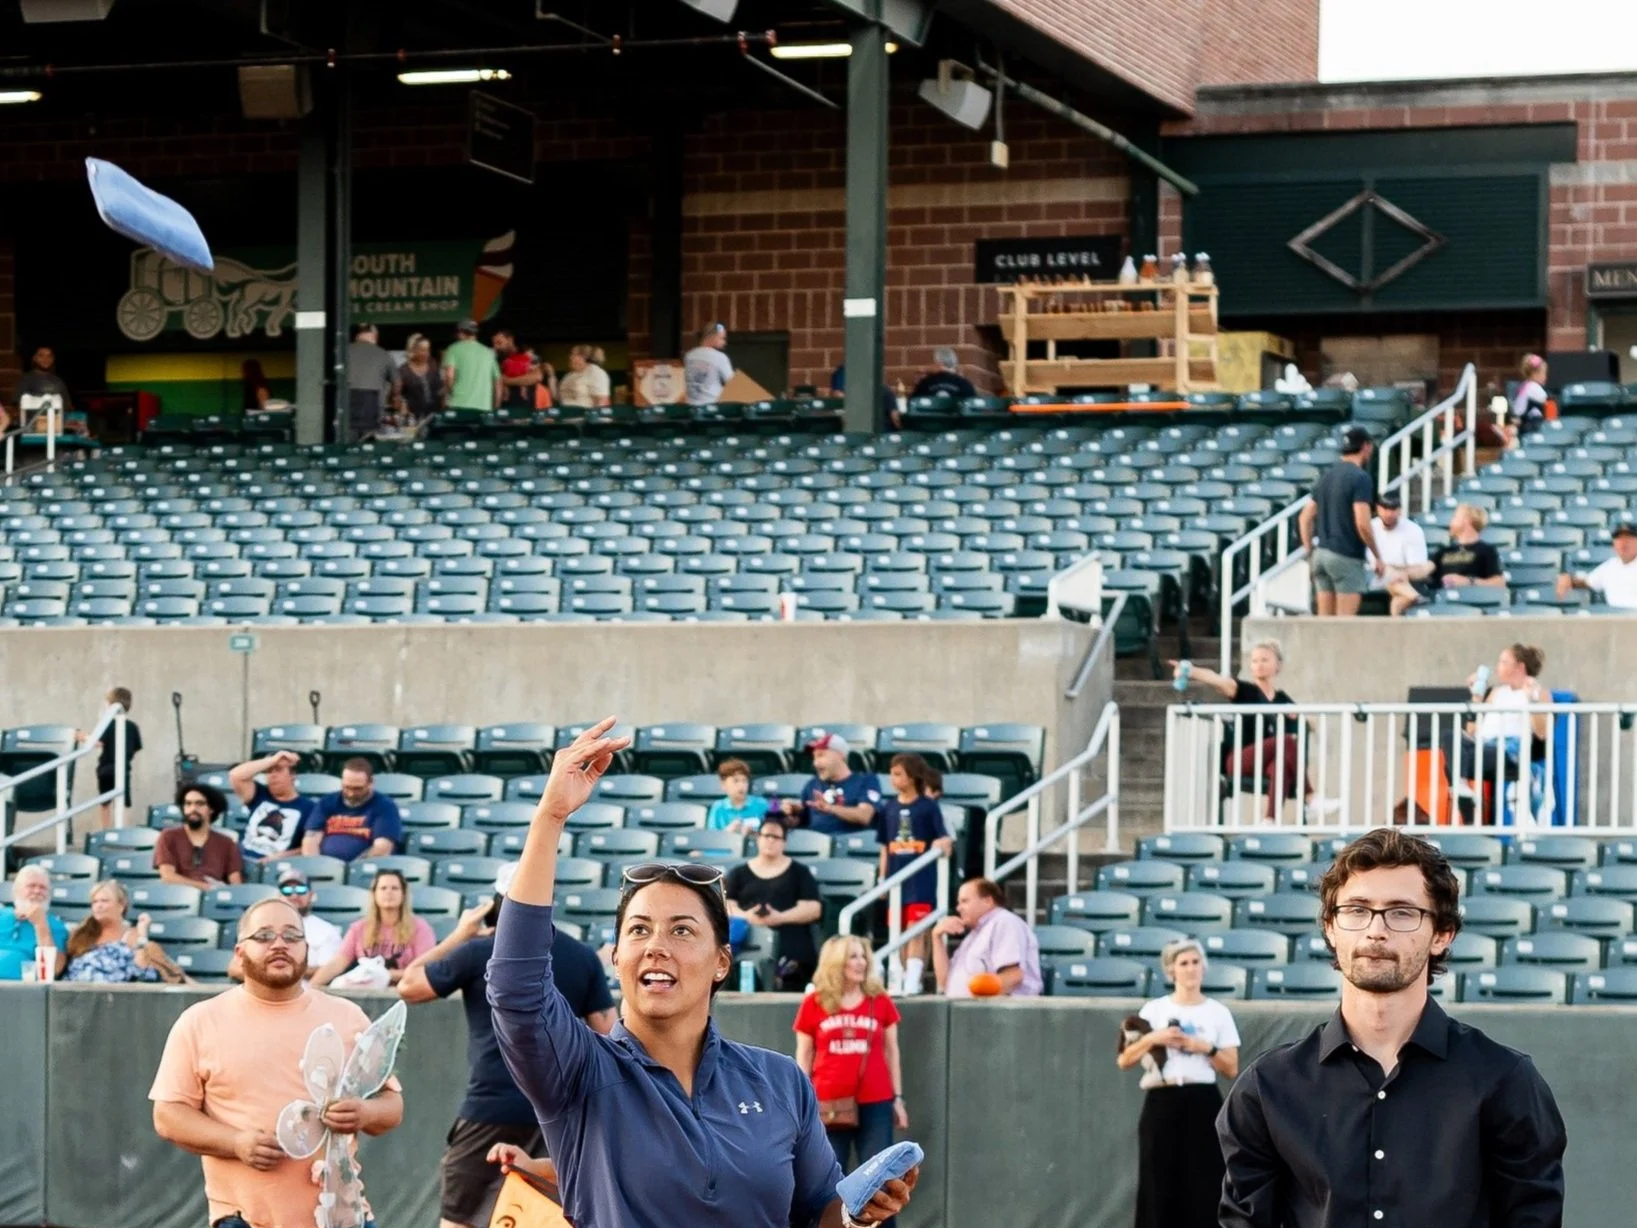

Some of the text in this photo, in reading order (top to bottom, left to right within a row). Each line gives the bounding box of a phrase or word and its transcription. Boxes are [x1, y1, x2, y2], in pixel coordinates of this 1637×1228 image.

[349, 252, 416, 274] OUTH
[994, 250, 1101, 268] CLUB LEVEL
[365, 301, 415, 313] CREAM
[420, 299, 460, 311] SHOP
